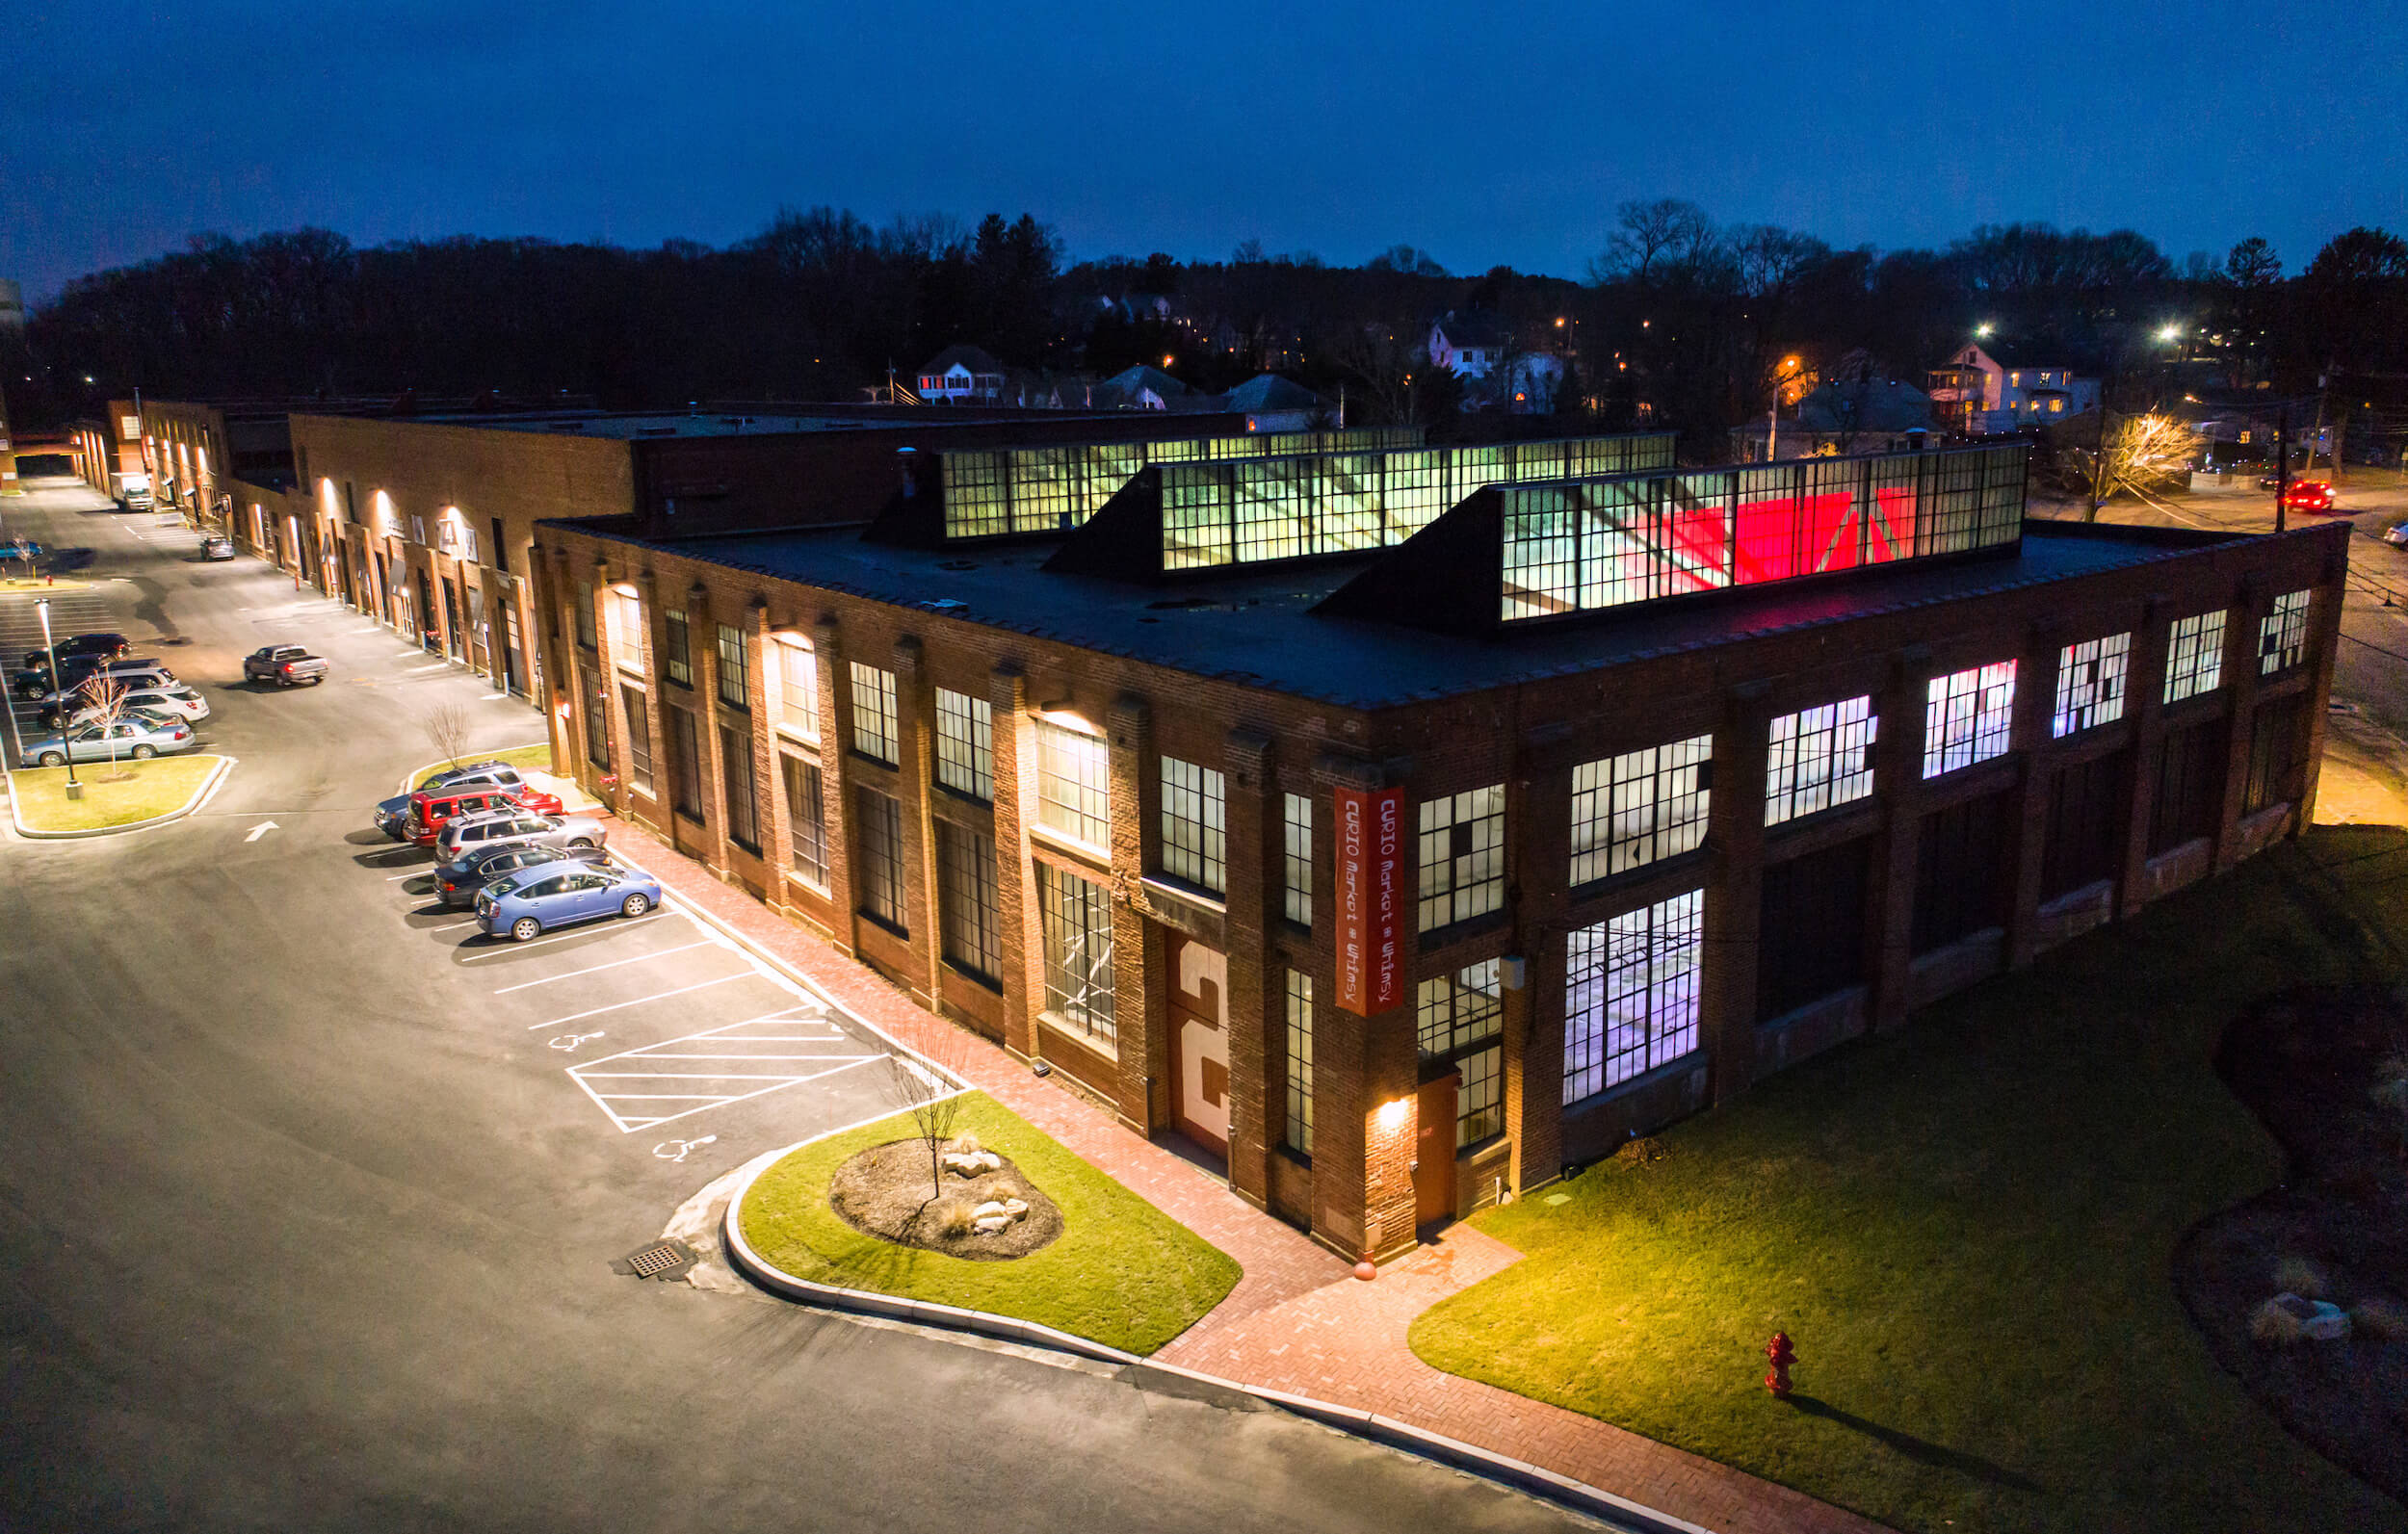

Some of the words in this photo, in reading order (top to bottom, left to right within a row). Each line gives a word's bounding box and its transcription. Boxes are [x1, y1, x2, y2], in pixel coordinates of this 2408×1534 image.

[1345, 800, 1360, 857] CURIO
[1380, 799, 1396, 856] CURIO
[1179, 939, 1229, 1143] 2
